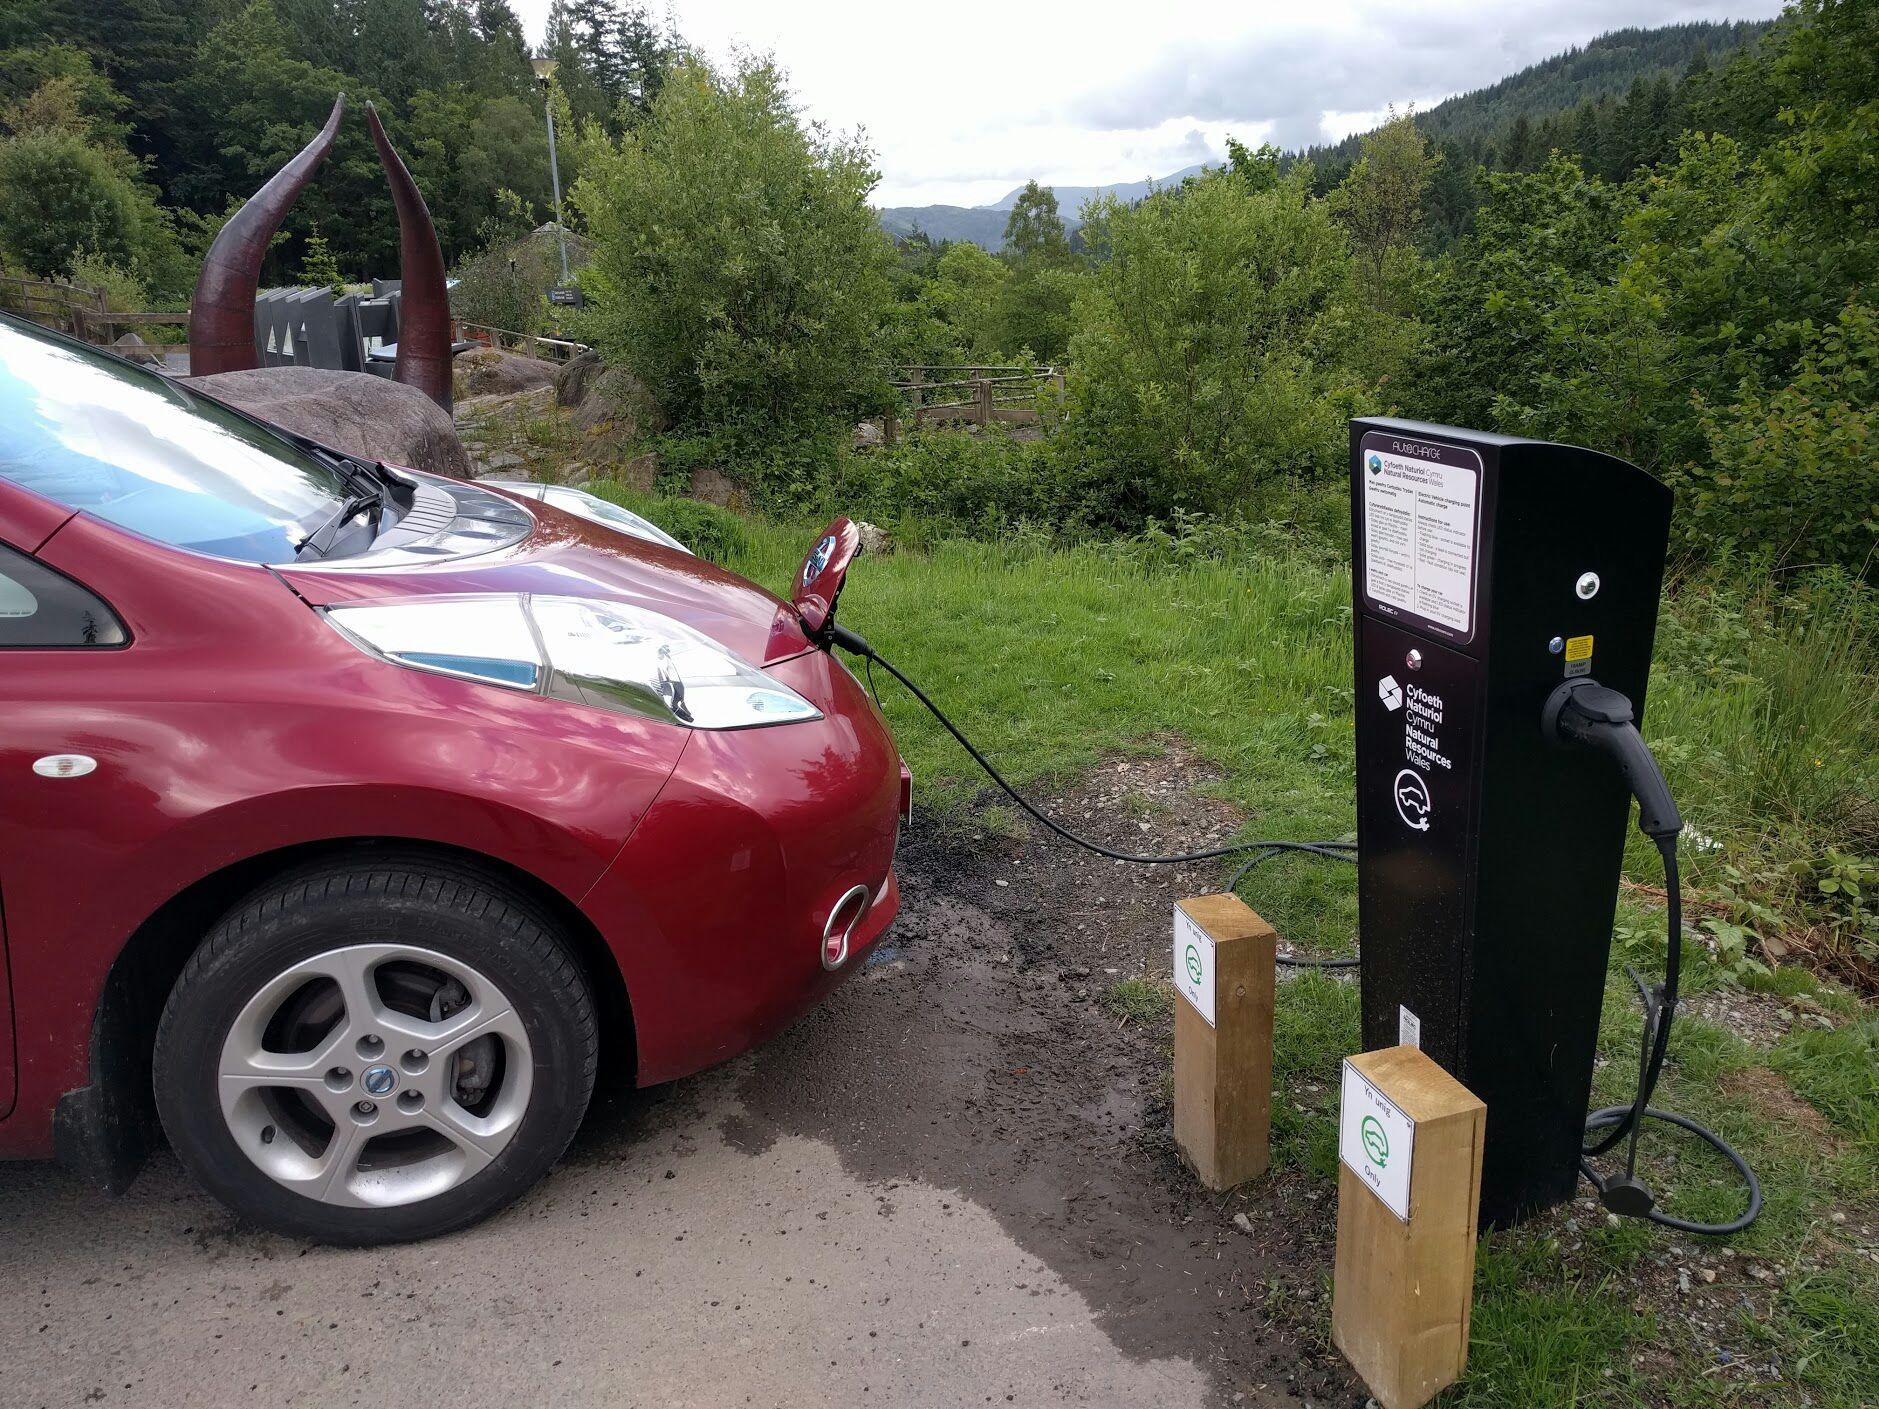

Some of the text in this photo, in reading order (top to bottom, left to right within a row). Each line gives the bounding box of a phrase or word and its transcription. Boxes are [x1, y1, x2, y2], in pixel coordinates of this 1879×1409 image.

[1384, 468, 1444, 488] Natural Resources Wales
[1406, 683, 1443, 710] Cyfoeth
[1406, 696, 1443, 724] Naturiol
[1406, 709, 1435, 733] Cymru
[1405, 724, 1439, 750] Natural
[1405, 738, 1452, 770] Resources
[1405, 748, 1431, 771] Wales
[1364, 1084, 1392, 1119] Yn unig
[1364, 1165, 1381, 1188] Only
